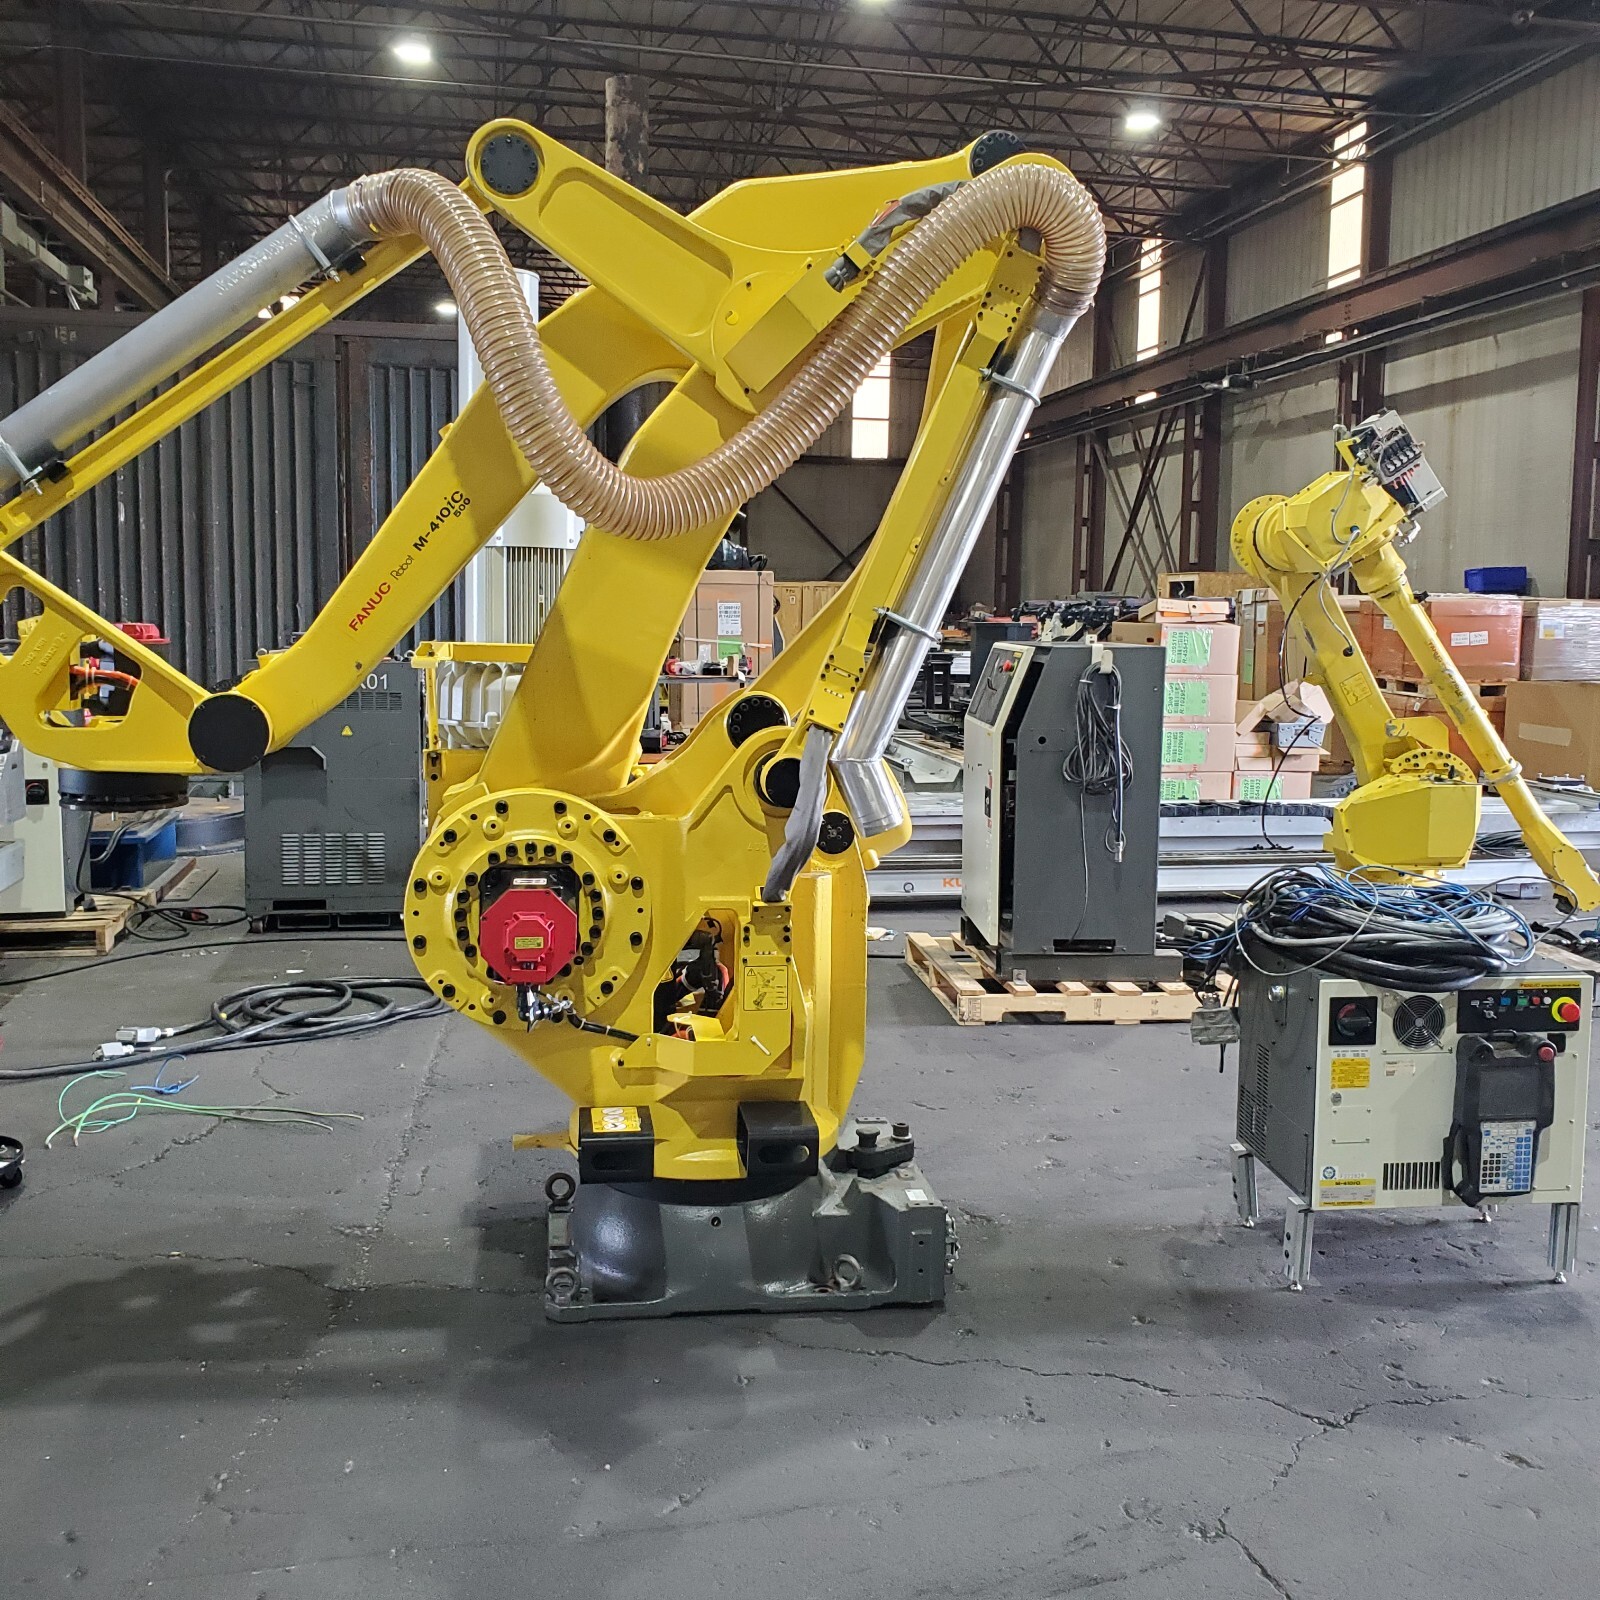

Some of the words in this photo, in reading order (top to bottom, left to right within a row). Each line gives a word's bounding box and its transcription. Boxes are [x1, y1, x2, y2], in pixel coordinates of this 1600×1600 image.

[453, 497, 471, 518] 500
[348, 582, 391, 631] FANUC
[390, 555, 415, 580] Robot
[412, 490, 464, 552] M-410iC
[360, 673, 388, 690] 01
